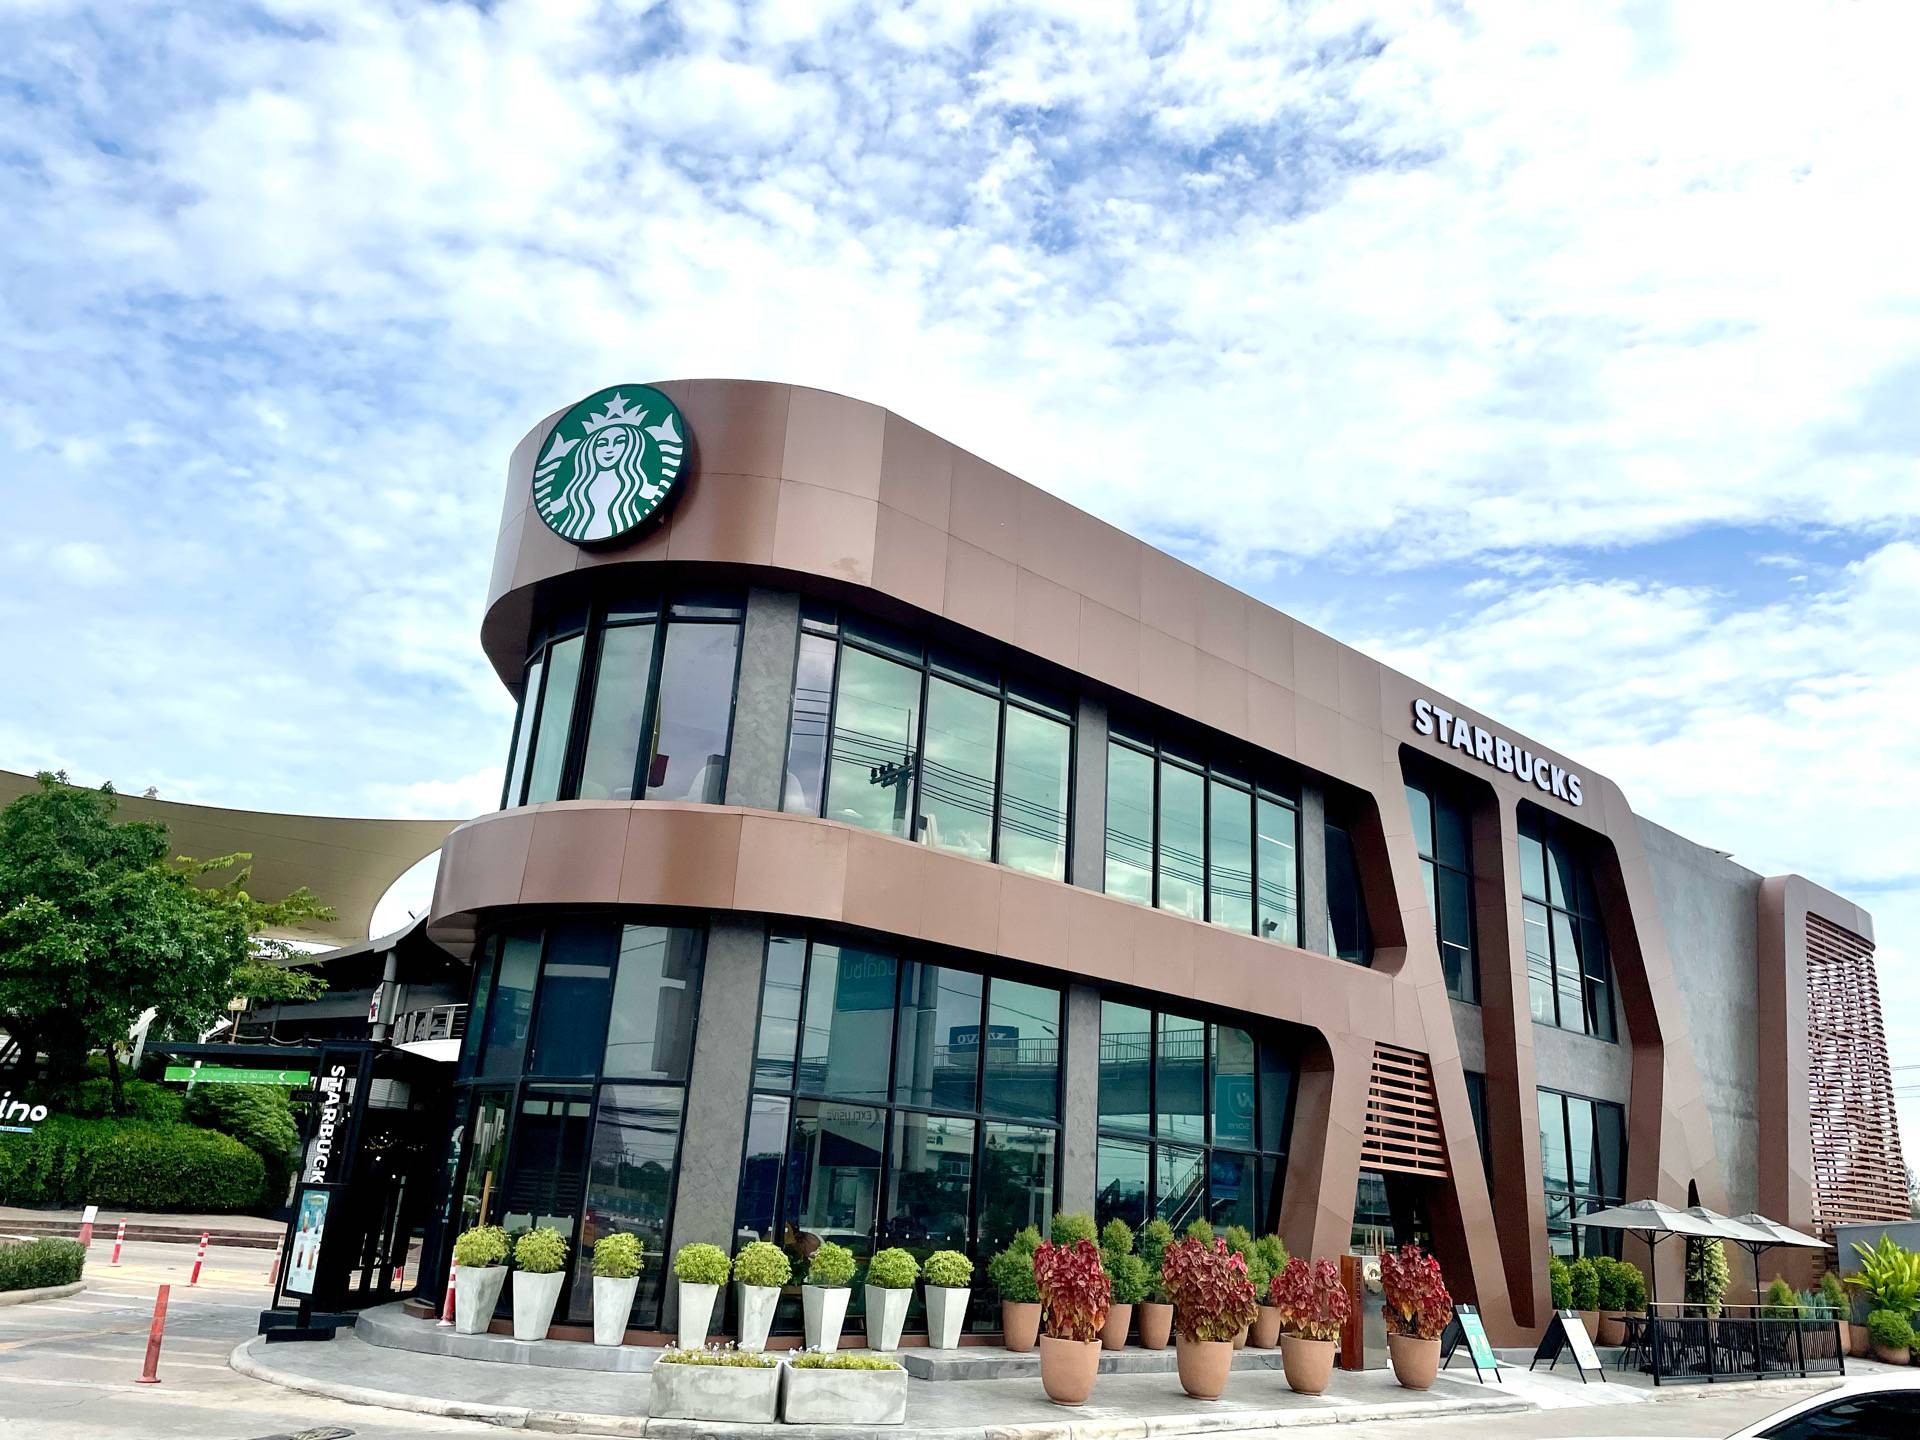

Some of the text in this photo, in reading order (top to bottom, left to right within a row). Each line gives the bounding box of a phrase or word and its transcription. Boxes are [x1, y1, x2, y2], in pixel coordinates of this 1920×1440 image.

[1414, 698, 1583, 806] STARBUCKS
[0, 1091, 48, 1122] ino
[310, 1065, 346, 1183] STARBUCK
